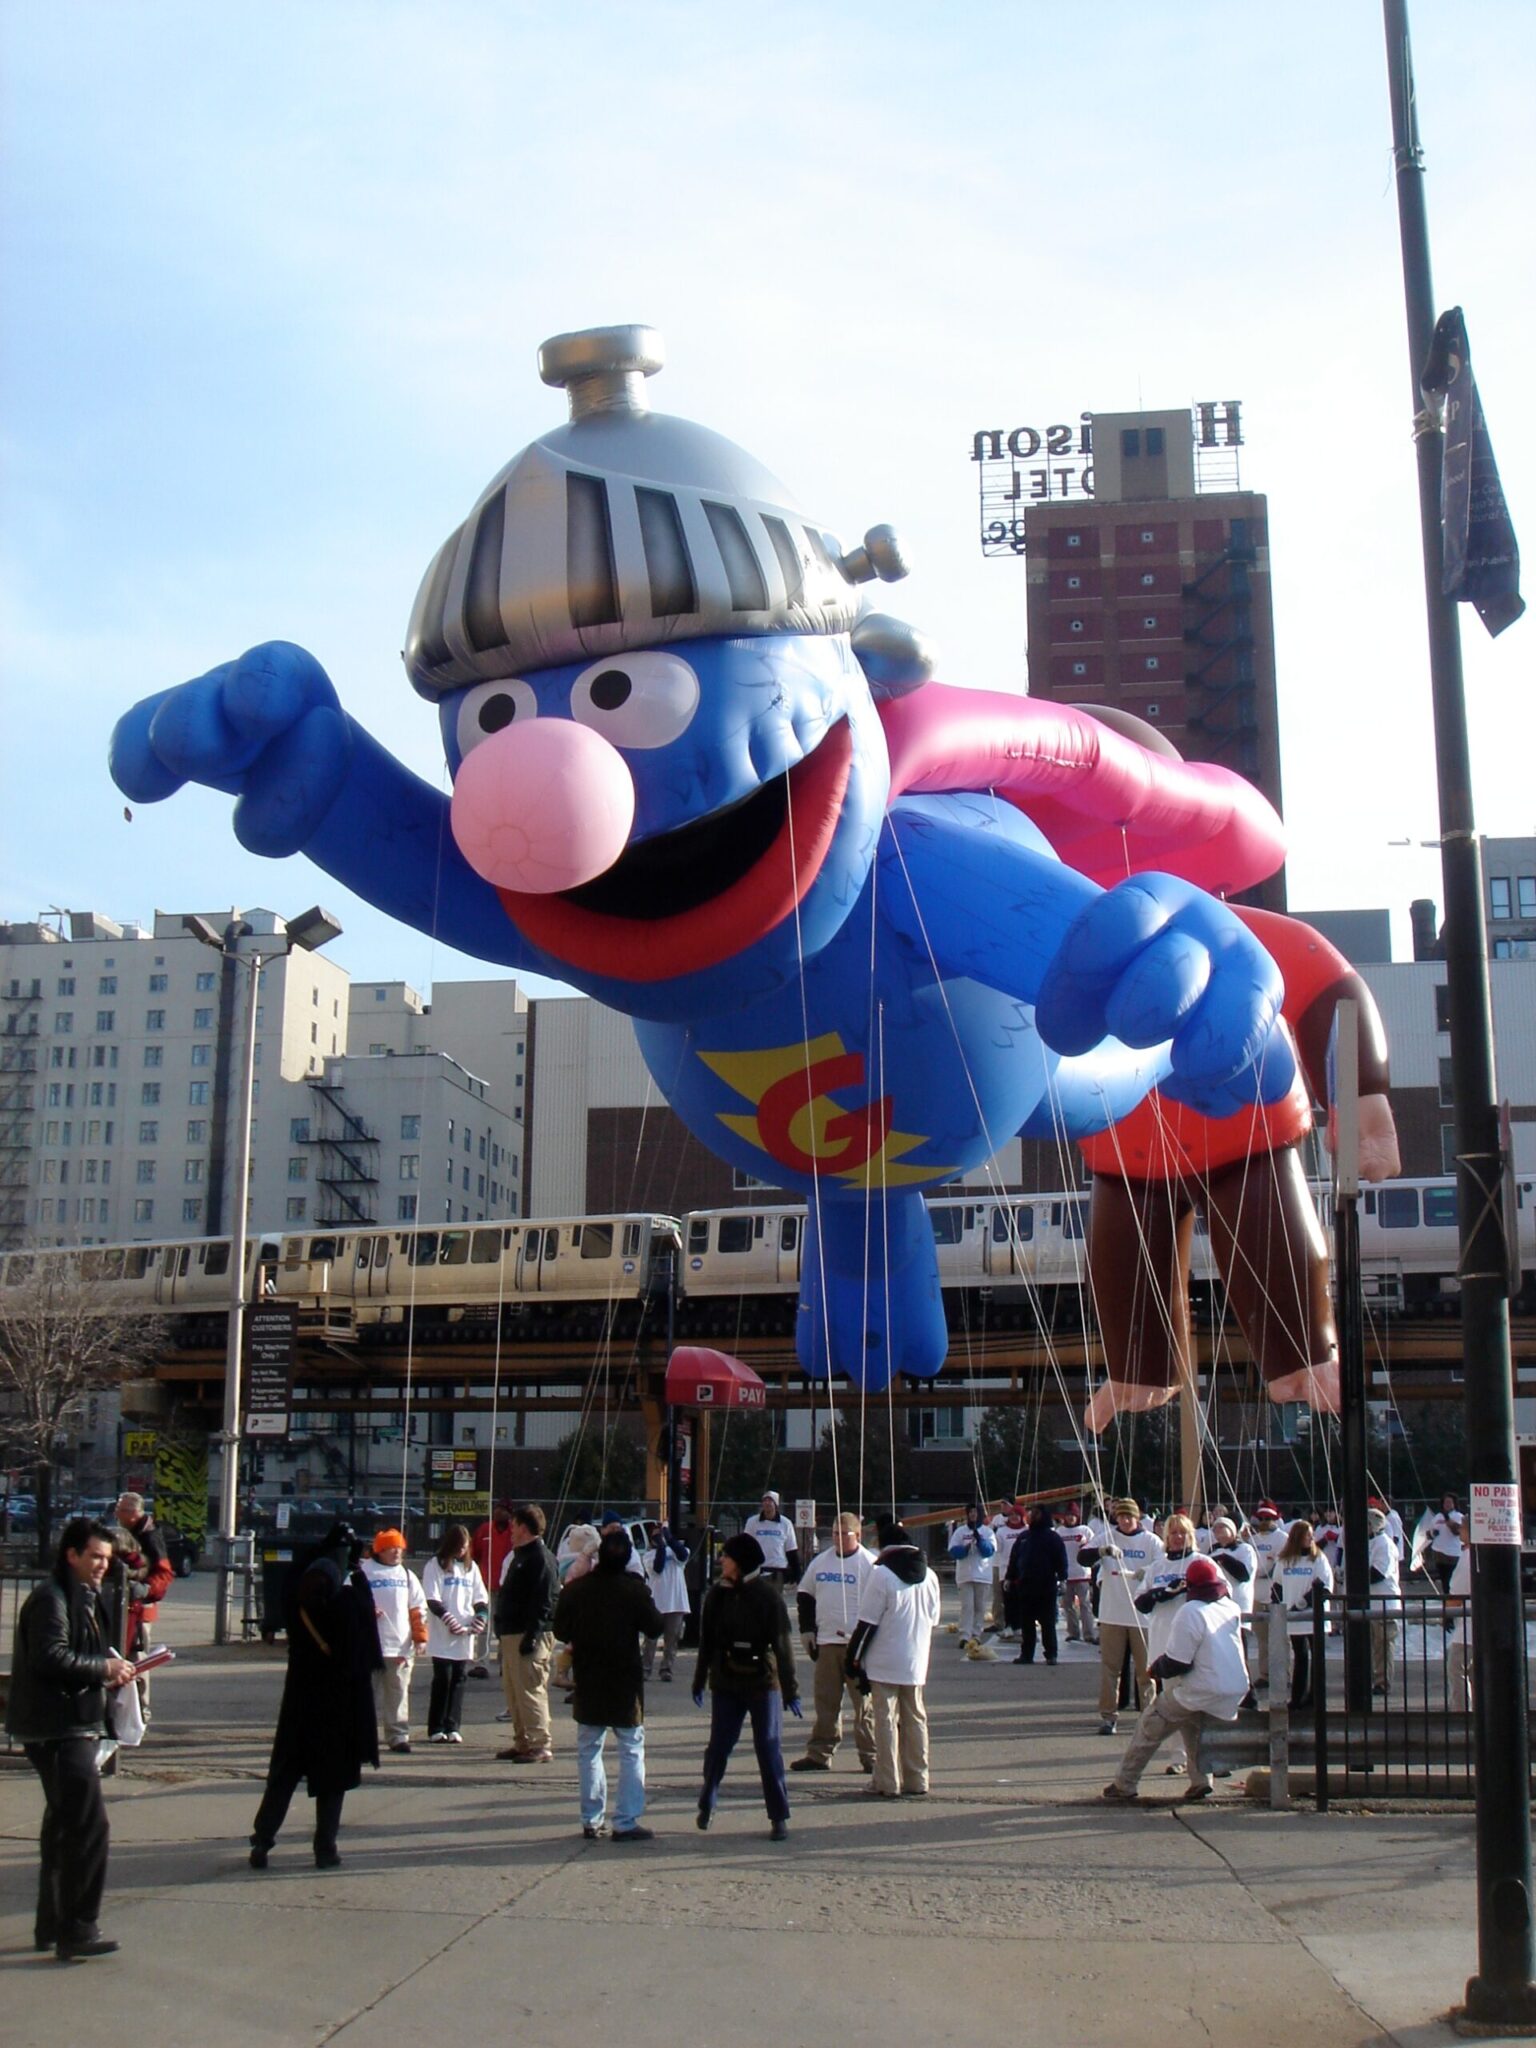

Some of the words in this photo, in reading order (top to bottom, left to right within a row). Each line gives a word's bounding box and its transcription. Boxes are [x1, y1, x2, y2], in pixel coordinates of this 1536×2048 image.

[757, 1052, 894, 1176] G
[254, 1314, 291, 1322] ATTENTION
[251, 1324, 292, 1332] CUSTOMERS
[1474, 1486, 1490, 1497] NO
[815, 1572, 857, 1585] KOBELCO
